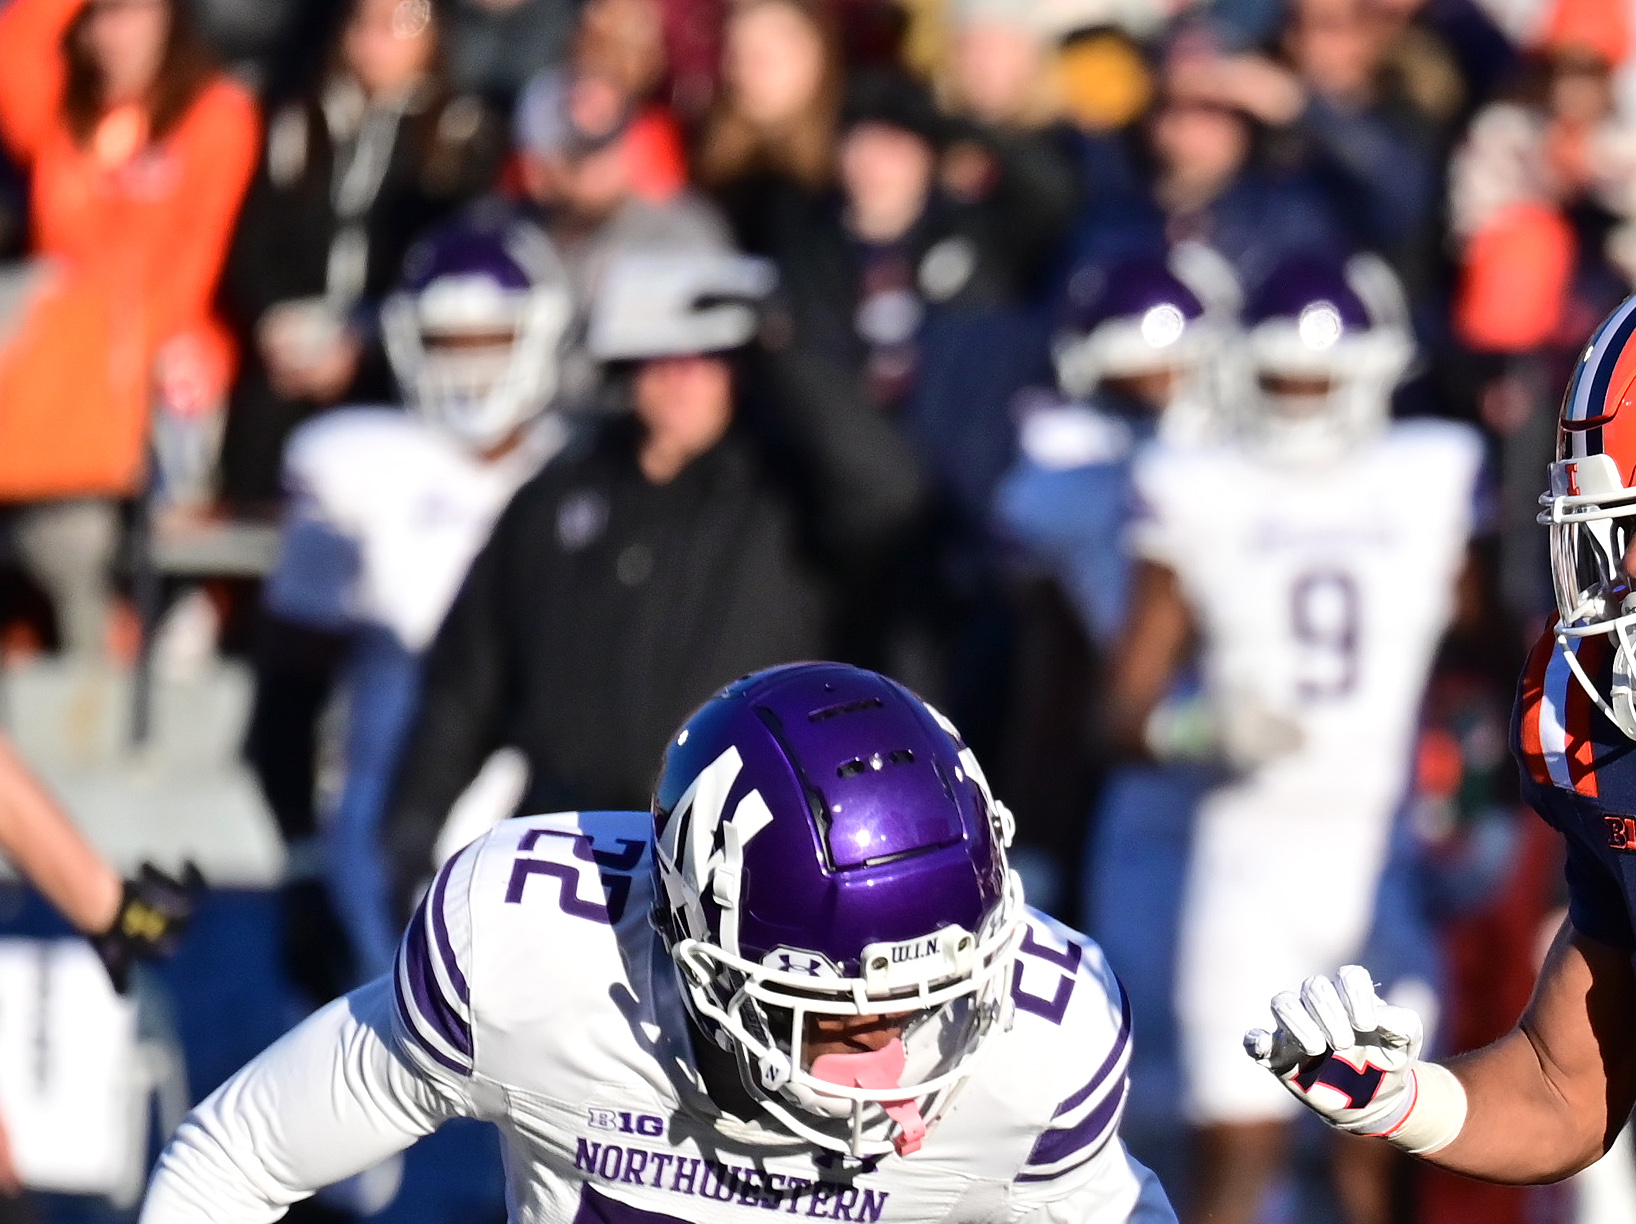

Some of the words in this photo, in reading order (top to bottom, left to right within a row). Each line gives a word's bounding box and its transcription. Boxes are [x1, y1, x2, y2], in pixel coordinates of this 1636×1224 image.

[1565, 463, 1581, 496] I
[1290, 566, 1362, 702] 9
[891, 937, 940, 963] W.I.N.
[765, 1064, 780, 1082] N
[574, 1136, 890, 1224] NORTHWESTERN
